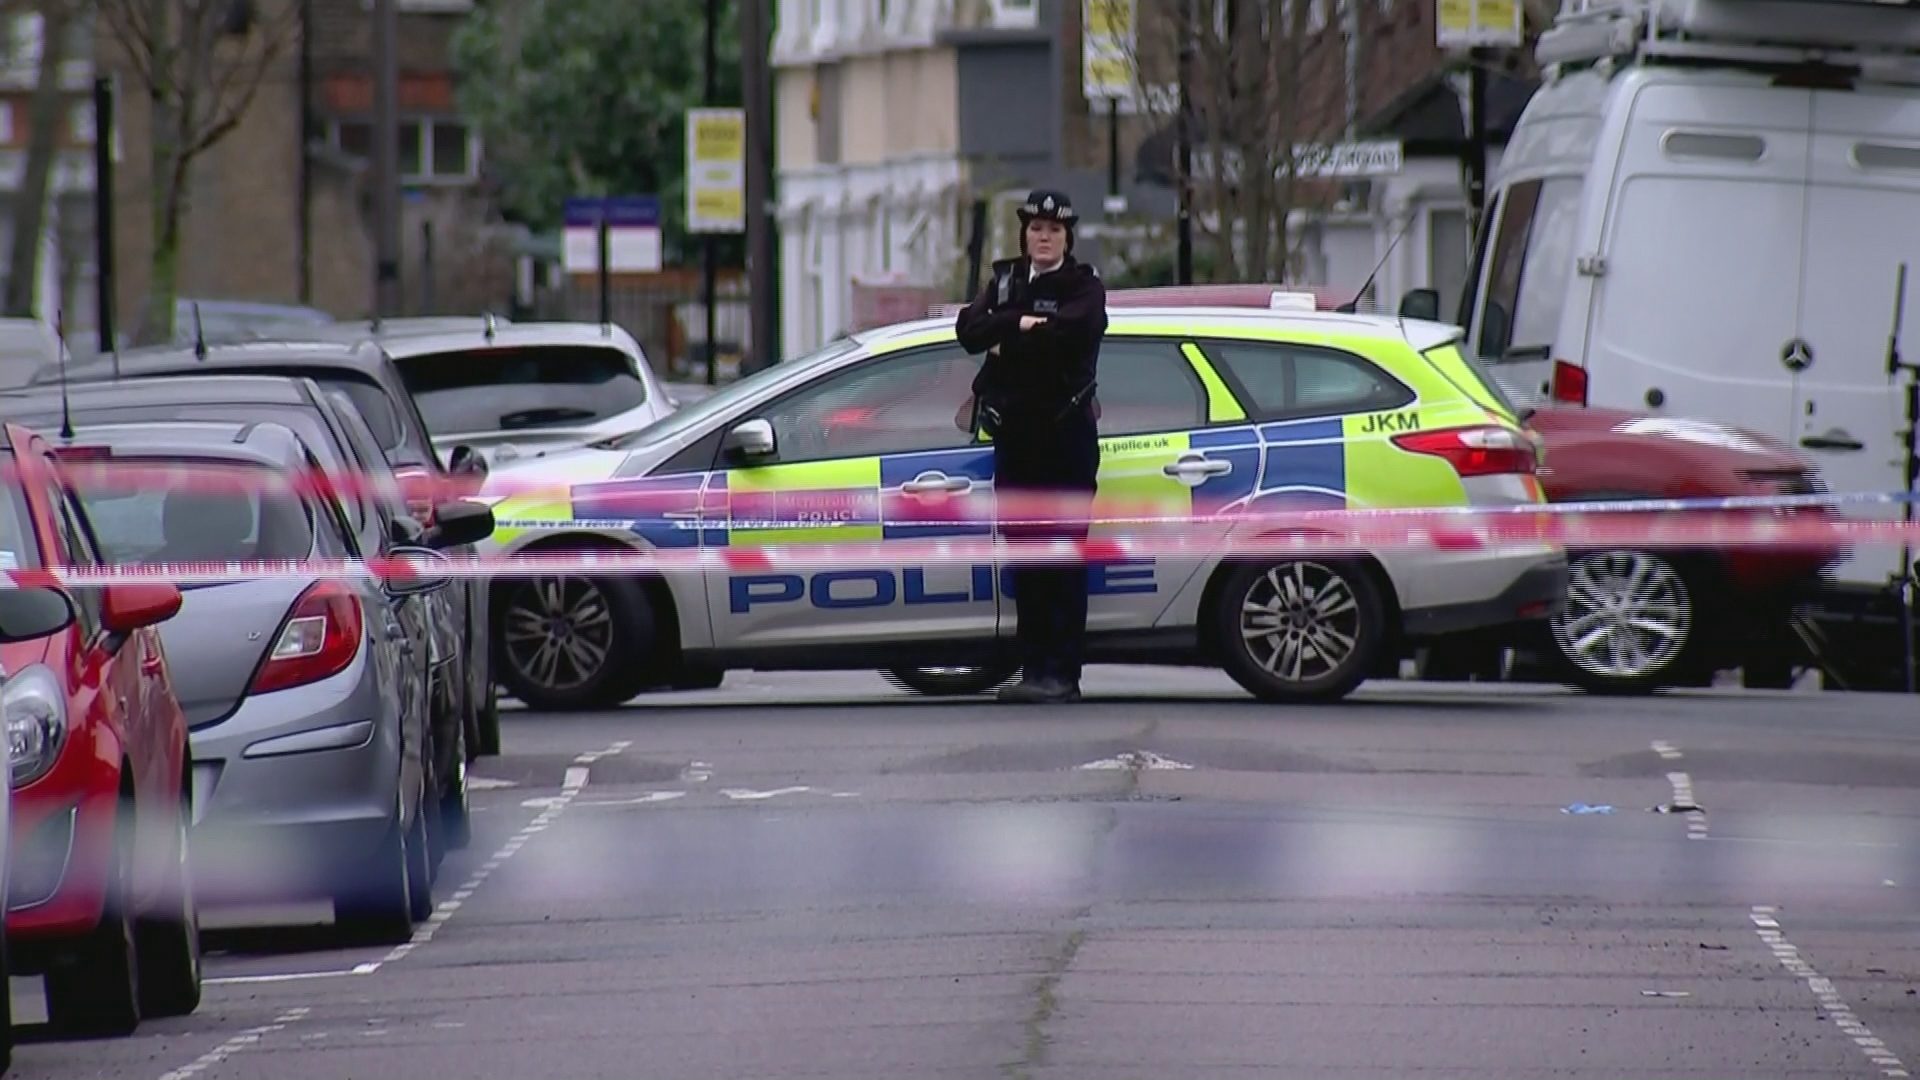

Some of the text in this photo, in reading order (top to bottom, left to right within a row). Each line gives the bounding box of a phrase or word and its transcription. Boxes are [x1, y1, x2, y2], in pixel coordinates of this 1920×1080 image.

[1361, 412, 1420, 433] JKM
[798, 510, 861, 521] POLICE
[728, 556, 1157, 614] POLIE
